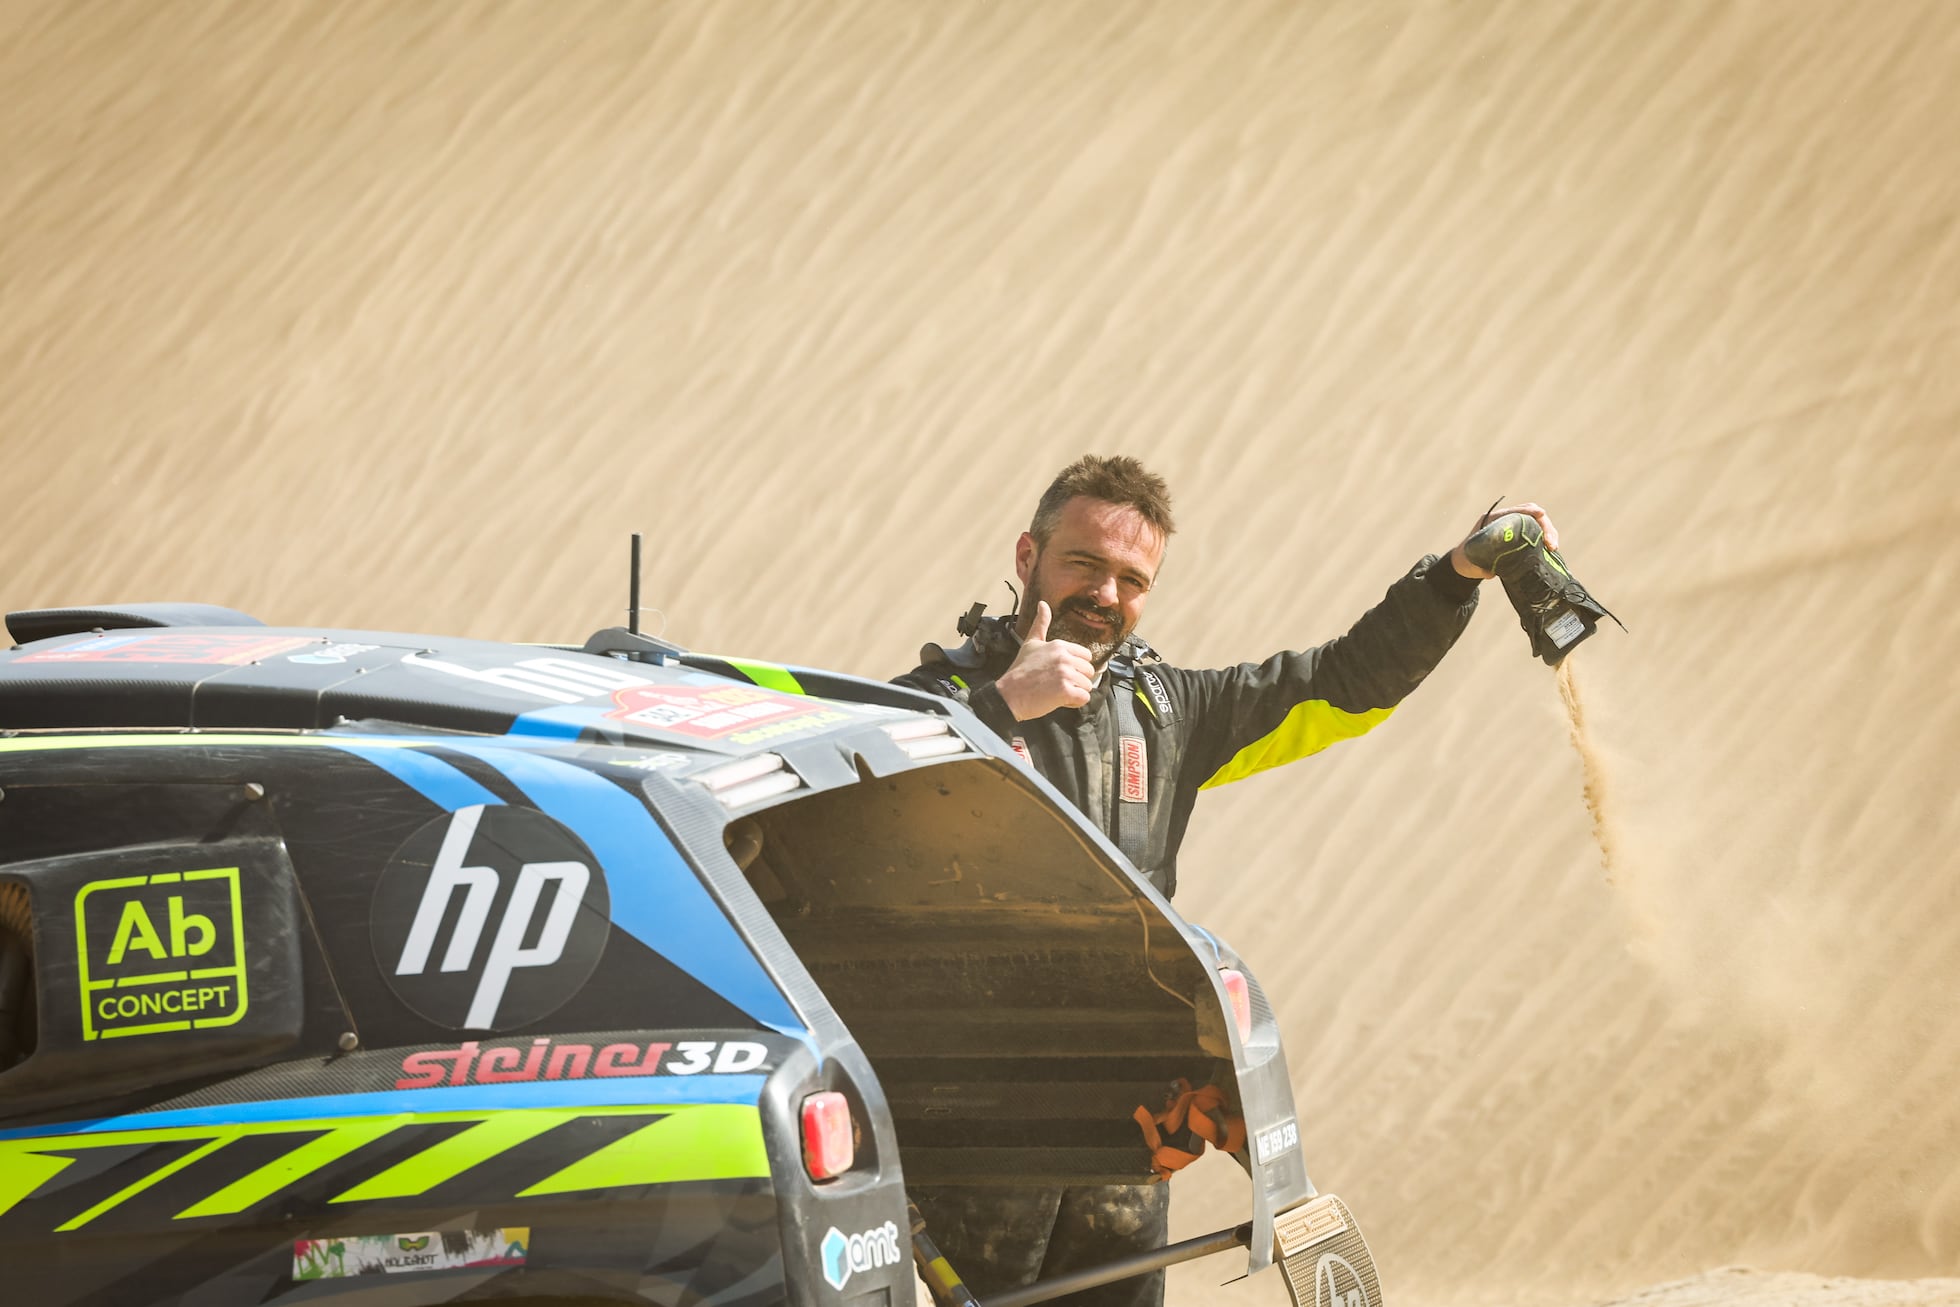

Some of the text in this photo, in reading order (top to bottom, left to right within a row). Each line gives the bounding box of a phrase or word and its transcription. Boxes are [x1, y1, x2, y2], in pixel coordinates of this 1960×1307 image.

[1143, 671, 1173, 713] sparco
[1127, 741, 1142, 797] SIMPSON
[106, 895, 217, 965] Ab
[395, 804, 590, 1030] hp
[98, 986, 231, 1020] CONCEPT
[1282, 1123, 1297, 1148] 238
[849, 1221, 900, 1272] amt
